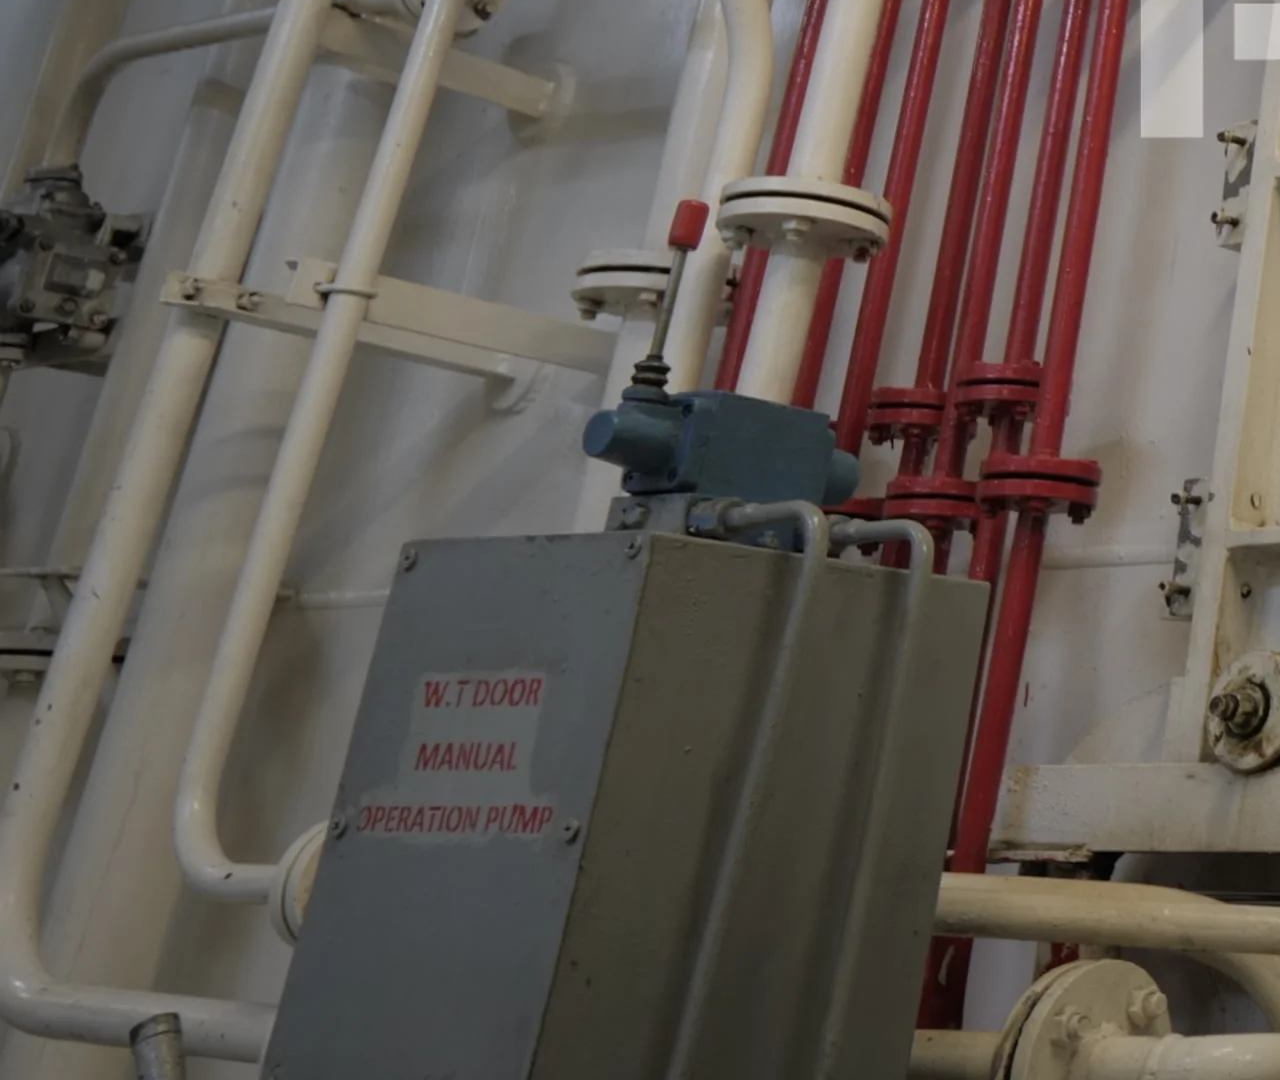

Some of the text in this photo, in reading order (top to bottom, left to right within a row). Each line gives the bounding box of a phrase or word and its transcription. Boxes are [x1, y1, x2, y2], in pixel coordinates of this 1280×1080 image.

[472, 678, 542, 707] DOOR
[414, 741, 517, 771] MANUAL
[356, 804, 554, 834] OPERATION PUMP
